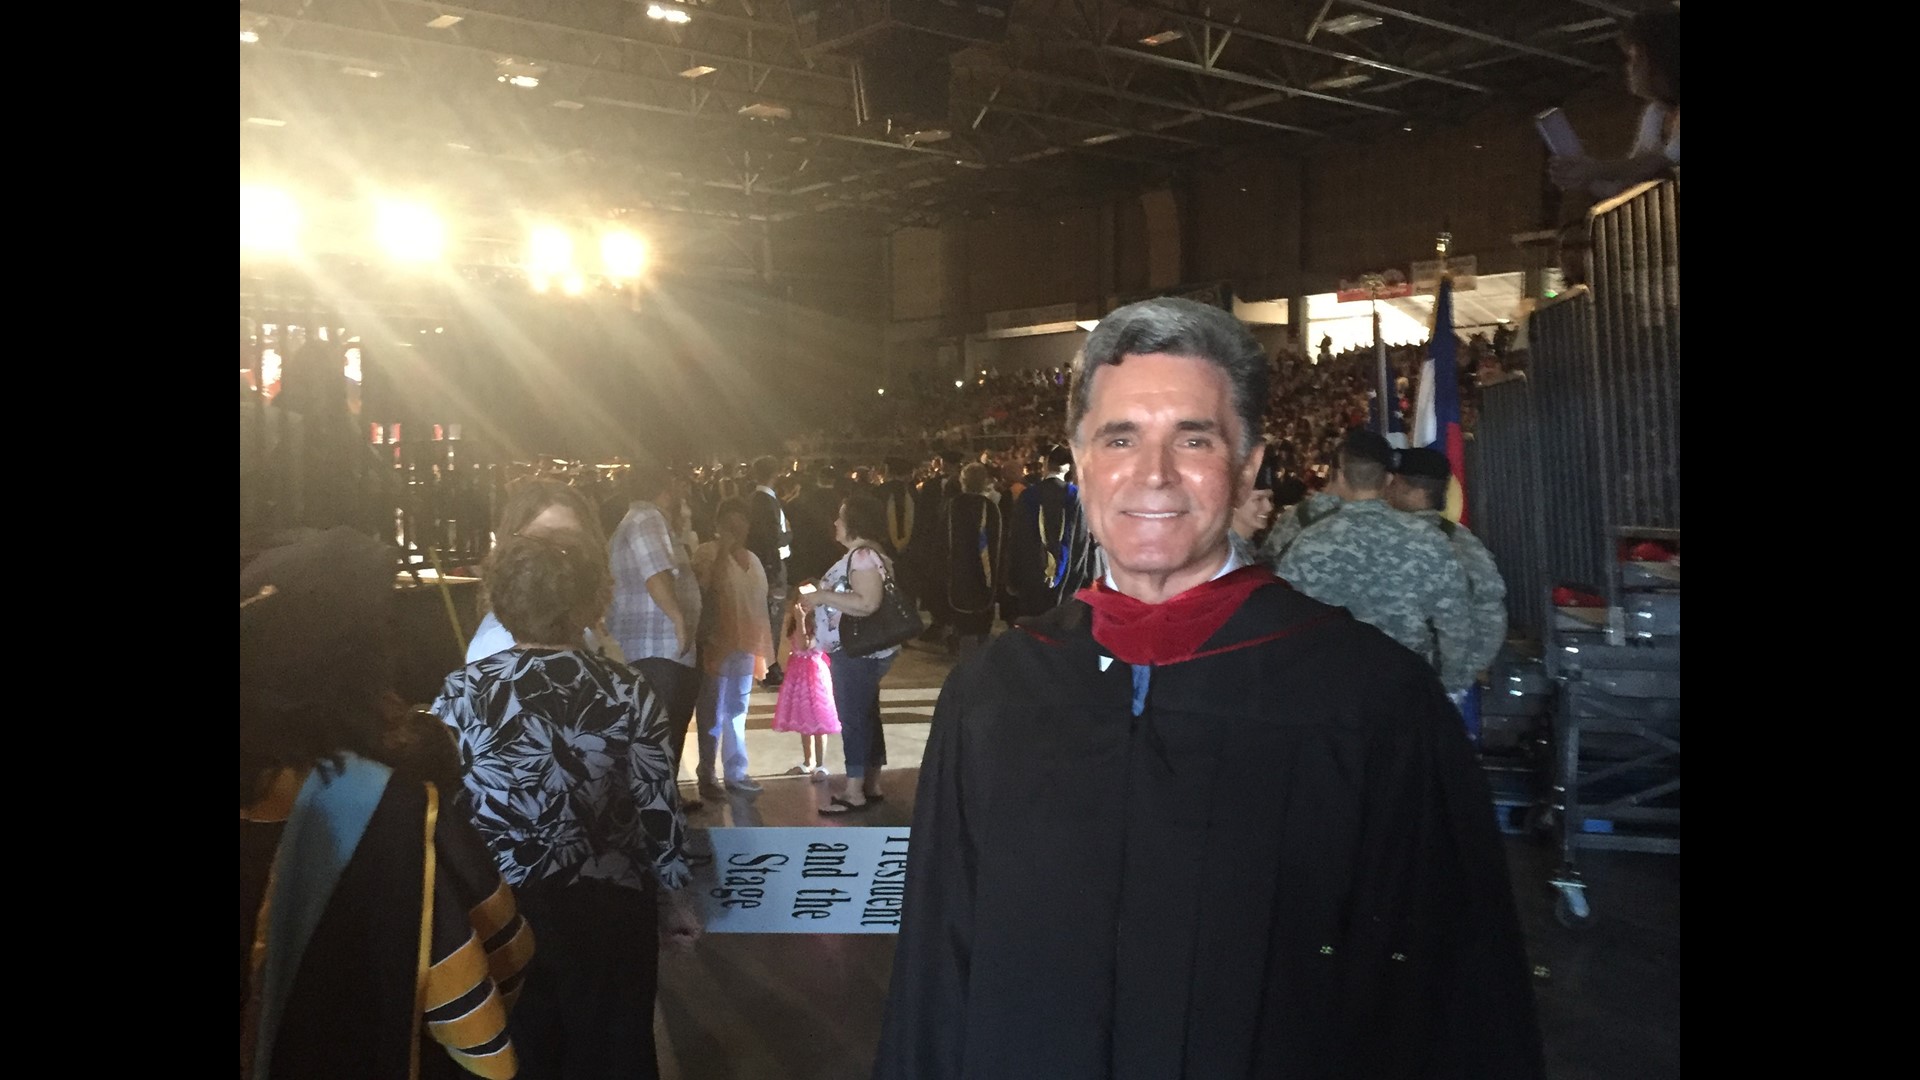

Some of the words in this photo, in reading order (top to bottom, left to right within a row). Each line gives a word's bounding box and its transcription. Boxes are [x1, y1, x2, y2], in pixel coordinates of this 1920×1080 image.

[802, 842, 859, 879] and
[710, 853, 790, 909] Stage
[791, 888, 852, 920] the
